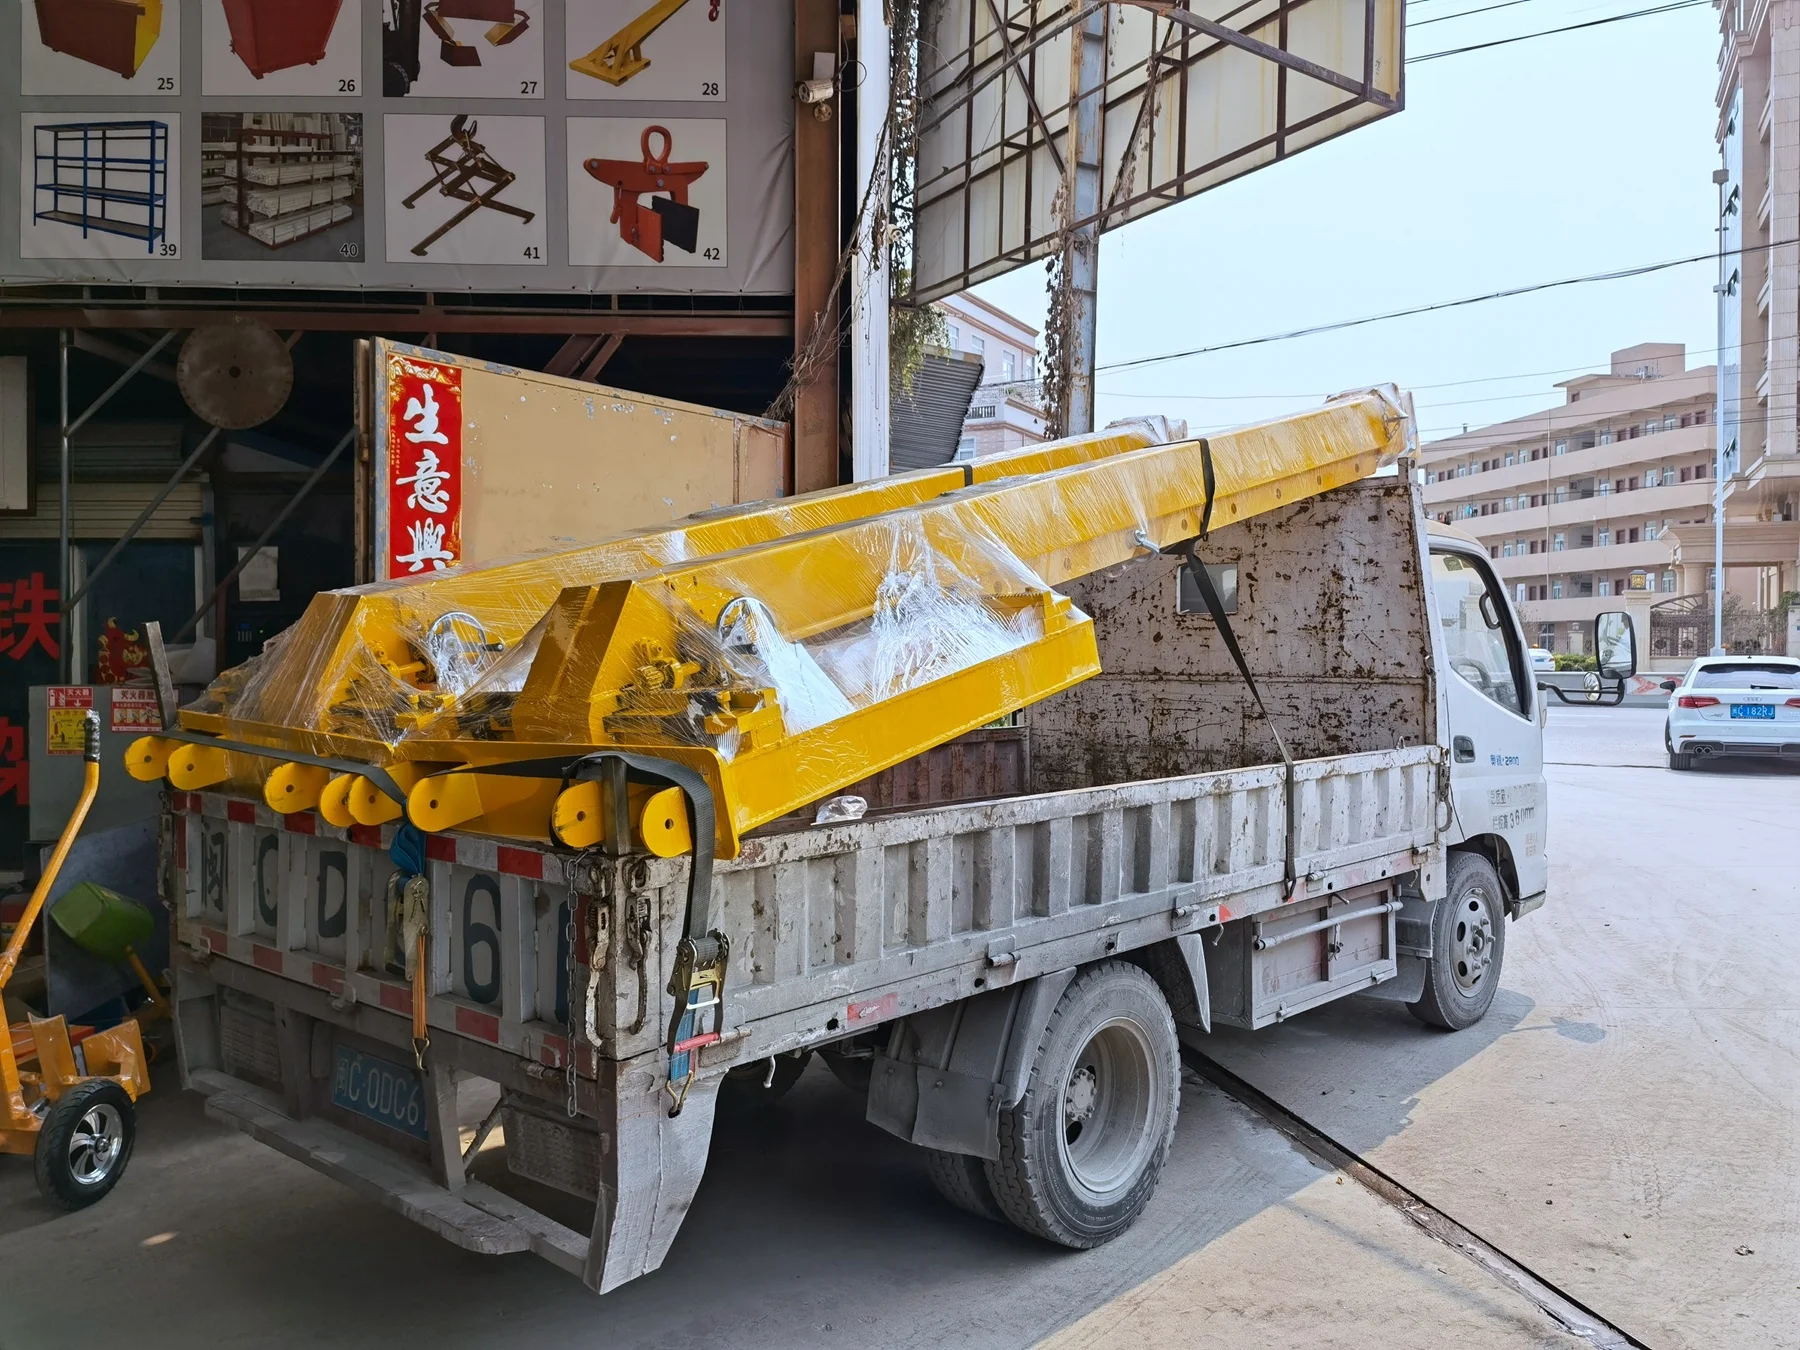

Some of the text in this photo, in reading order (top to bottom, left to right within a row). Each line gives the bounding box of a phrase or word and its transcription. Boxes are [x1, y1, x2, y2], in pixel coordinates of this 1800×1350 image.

[157, 77, 174, 91] 25
[338, 79, 356, 92] 26
[520, 81, 538, 94] 27
[702, 82, 720, 96] 28
[159, 243, 177, 257] 39
[340, 243, 358, 257] 40
[523, 246, 541, 260] 41
[703, 247, 721, 261] 42
[67, 688, 90, 696] 灭火器
